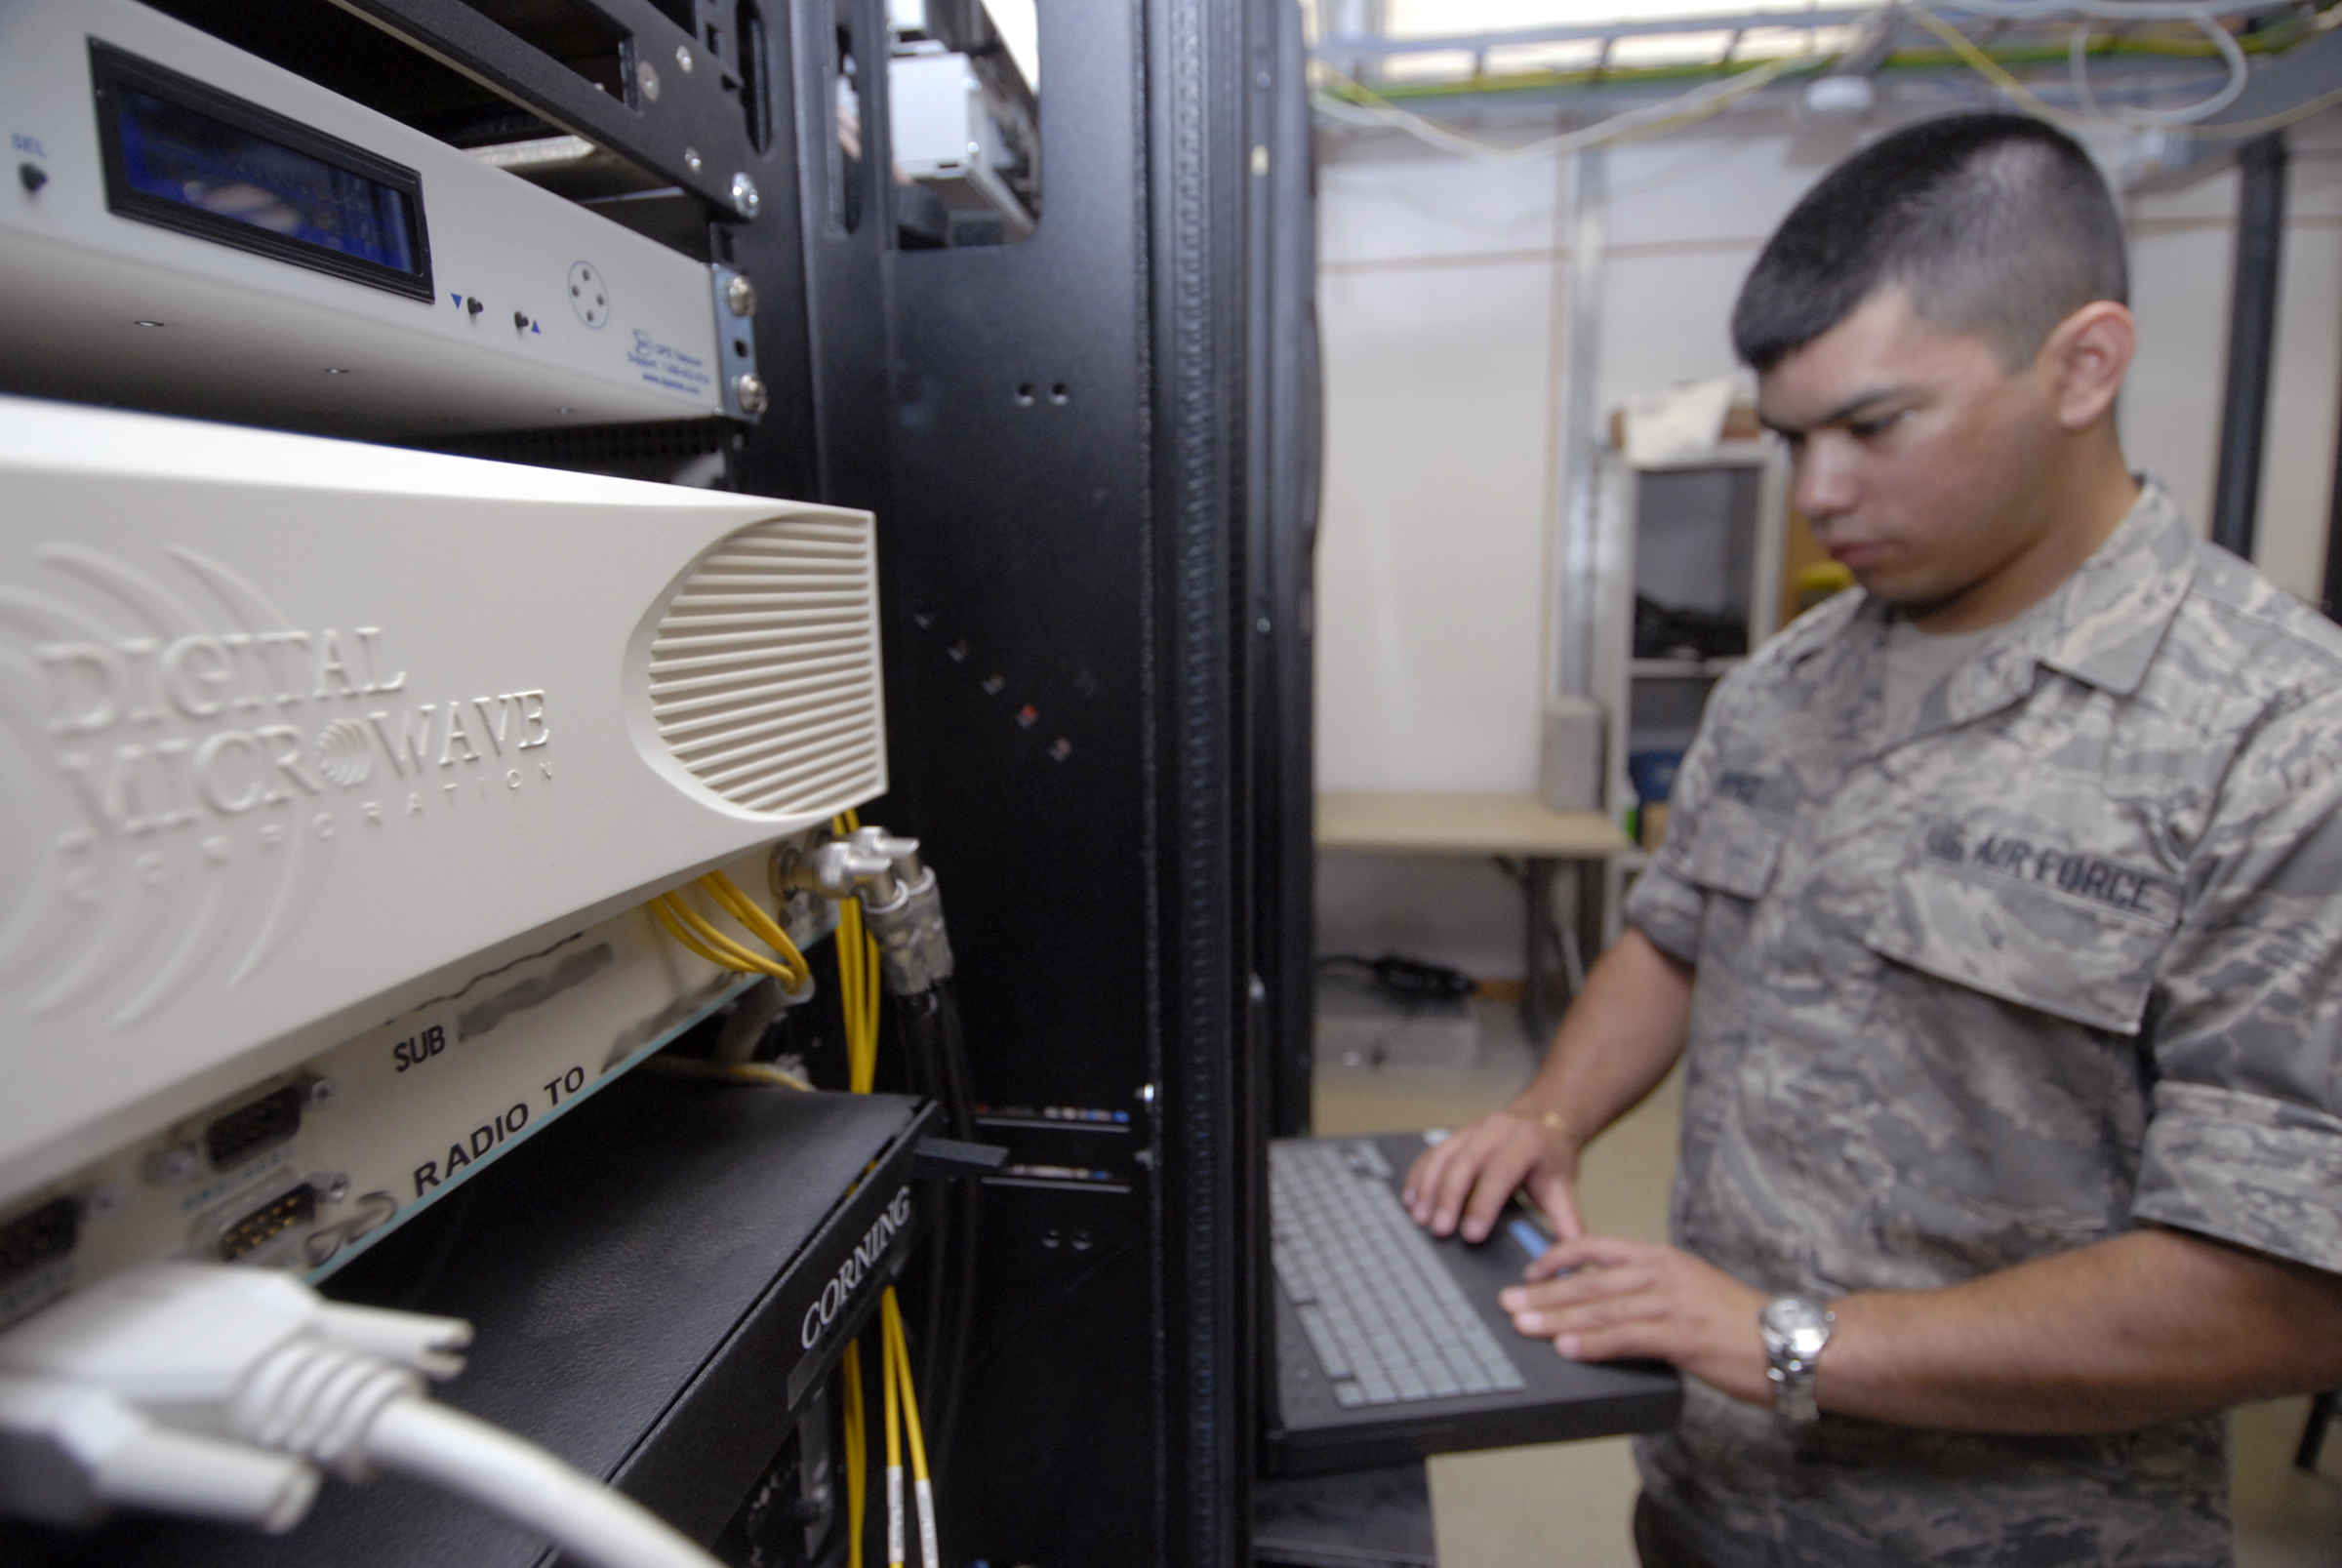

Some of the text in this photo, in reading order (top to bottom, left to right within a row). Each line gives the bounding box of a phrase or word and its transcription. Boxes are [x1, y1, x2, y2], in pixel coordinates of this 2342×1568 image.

[35, 625, 407, 739] DIGITAL
[56, 688, 550, 856] MICROWAVE
[57, 761, 553, 905] CORPORATION
[1974, 833, 2033, 879] AIR
[2035, 846, 2155, 911] FORCE
[393, 1025, 446, 1073] SUB
[414, 1065, 585, 1199] RADIO TO
[802, 1186, 910, 1349] CORNING
